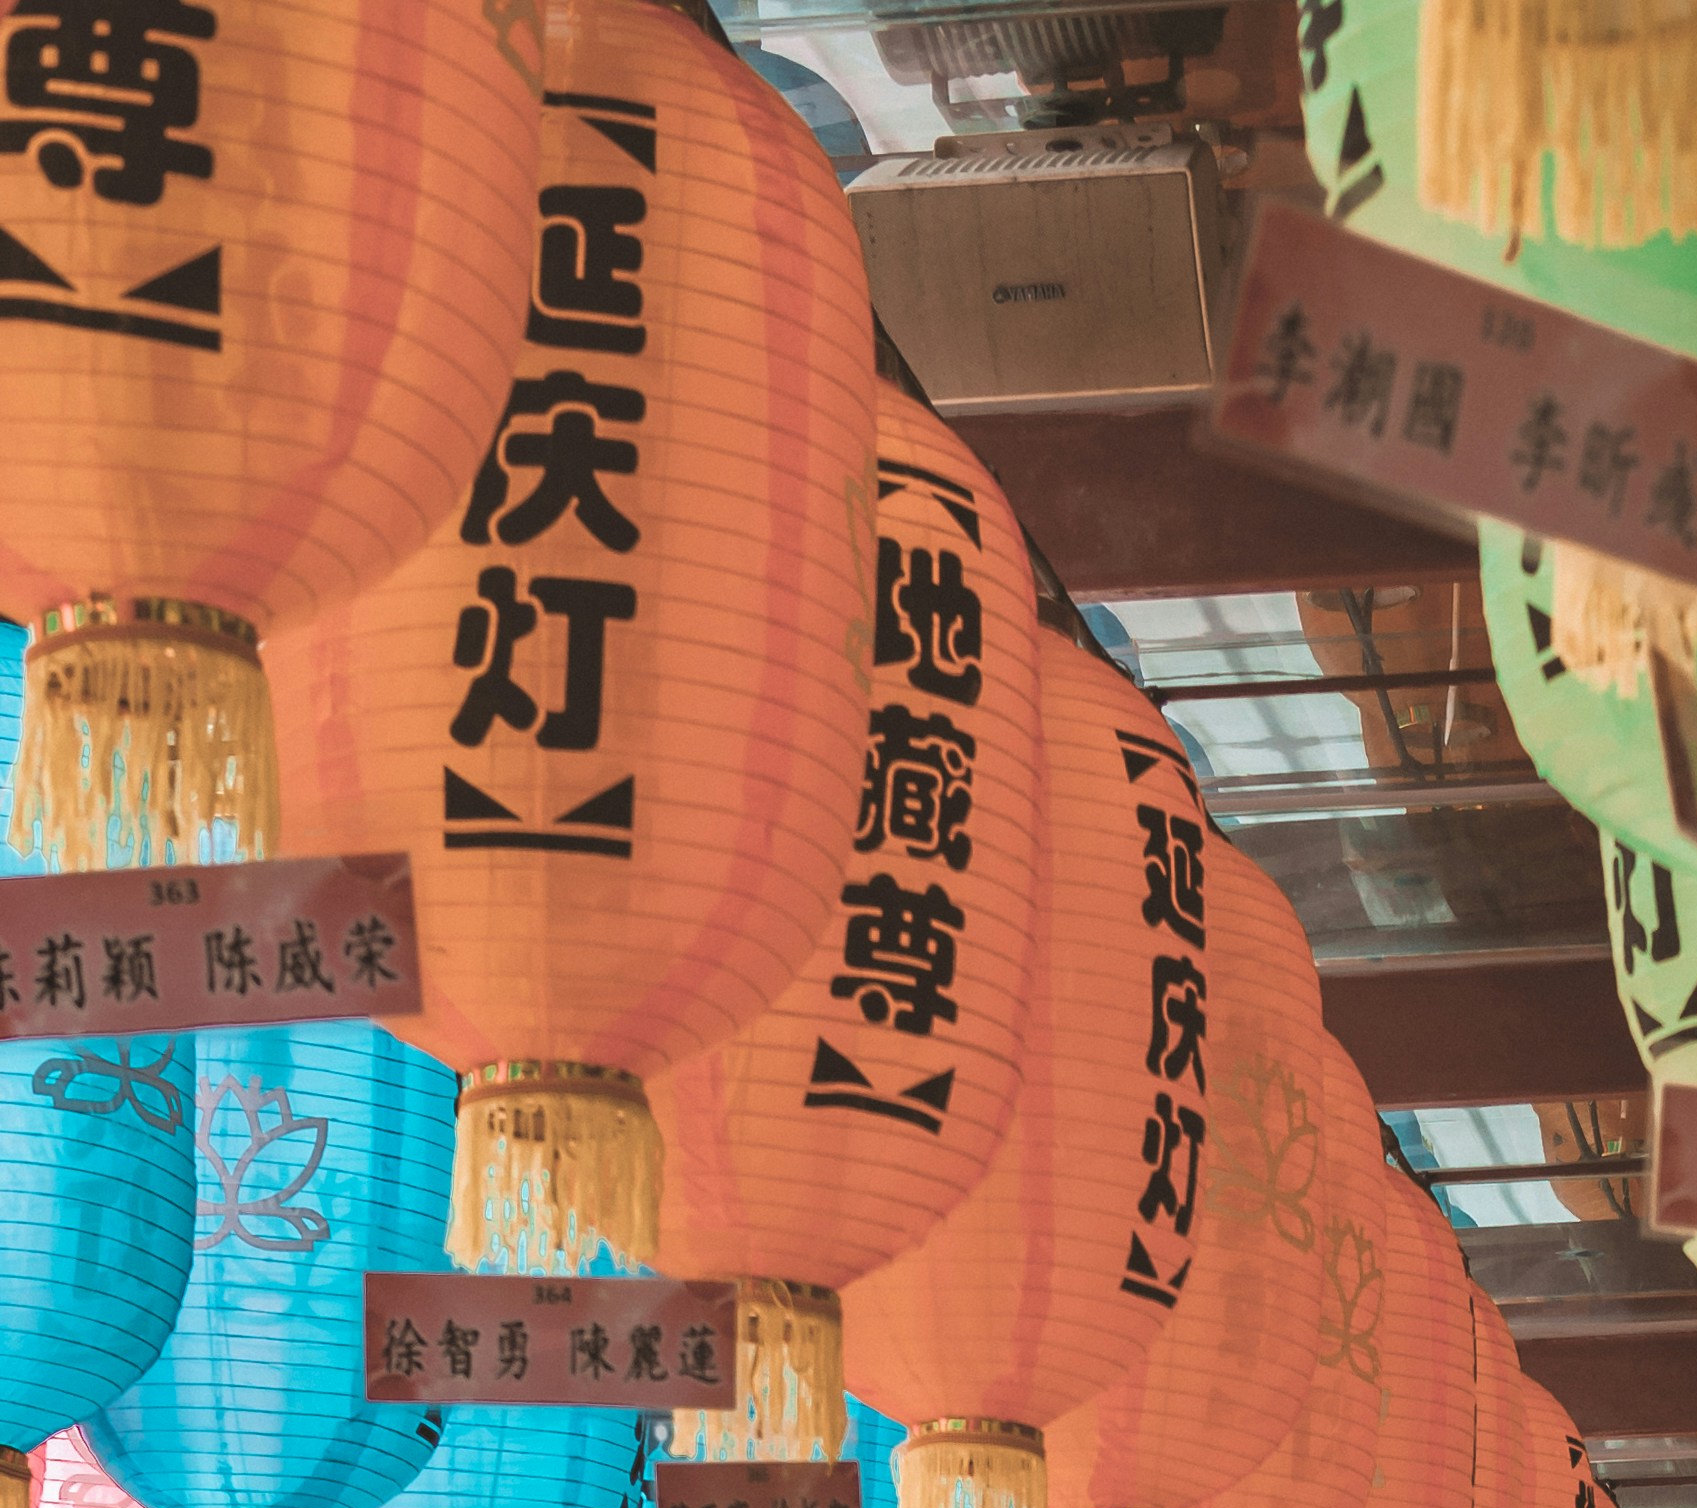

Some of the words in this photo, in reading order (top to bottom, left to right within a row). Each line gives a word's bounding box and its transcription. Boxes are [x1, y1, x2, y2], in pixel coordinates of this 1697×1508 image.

[149, 880, 200, 905] 363
[204, 916, 402, 996] 陈威荣
[380, 1317, 531, 1378] 徐智勇
